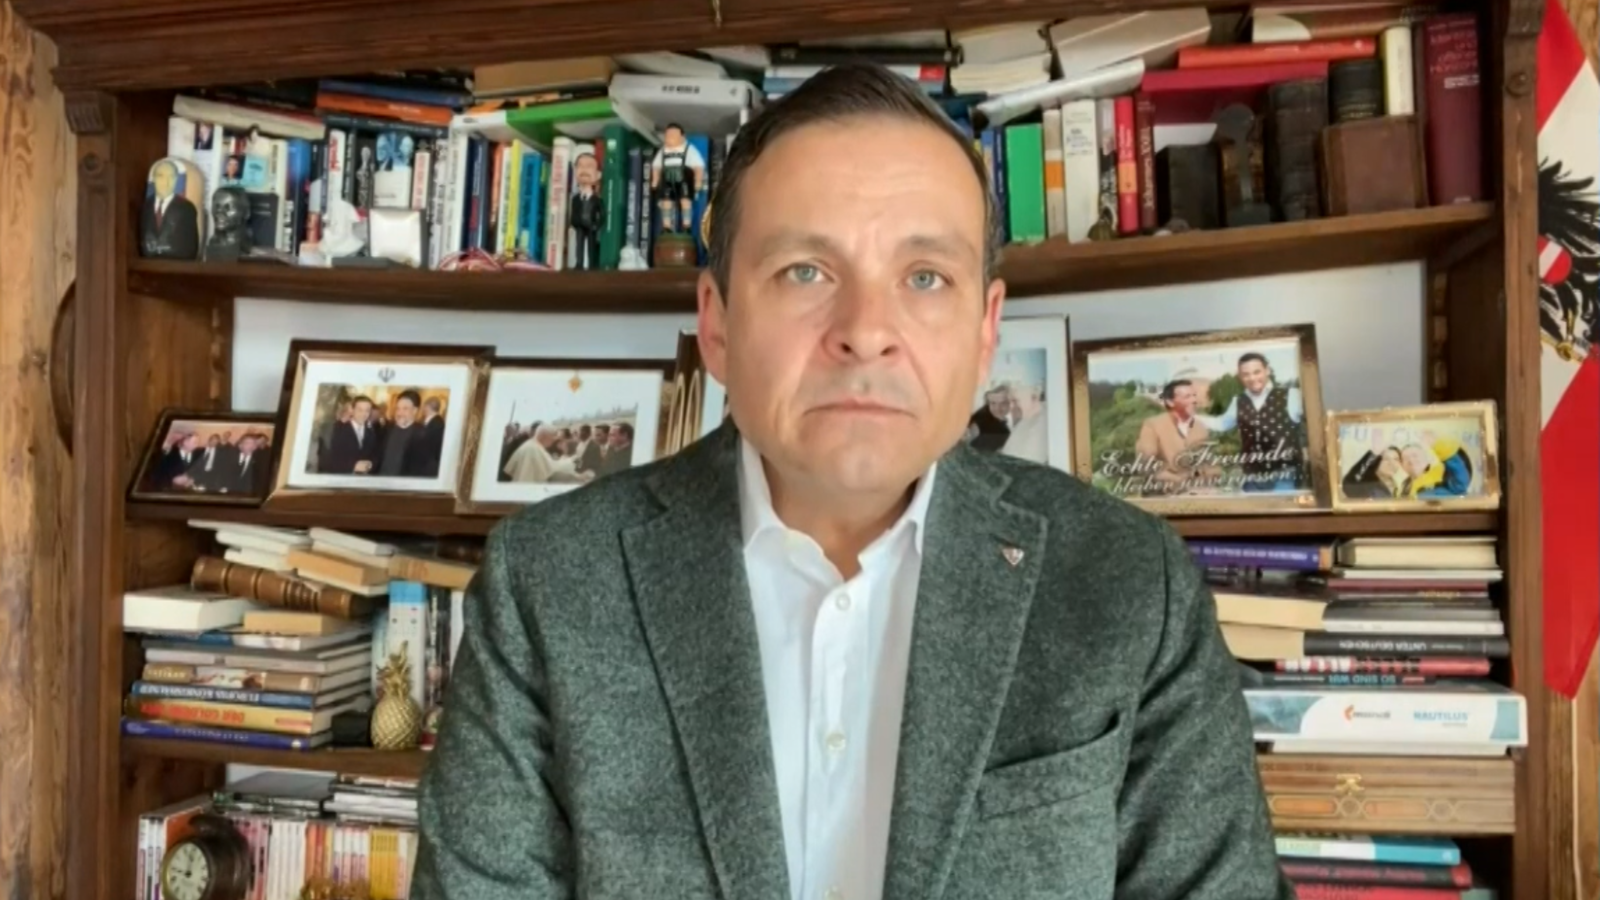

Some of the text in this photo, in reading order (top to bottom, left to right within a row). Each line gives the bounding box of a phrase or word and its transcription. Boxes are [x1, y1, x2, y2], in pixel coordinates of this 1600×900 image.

[1101, 438, 1294, 477] Echte Freunde
[1328, 674, 1350, 685] WIR
[1352, 674, 1378, 686] SIND
[1380, 674, 1397, 686] SO
[1413, 711, 1469, 721] NAUTILUS
